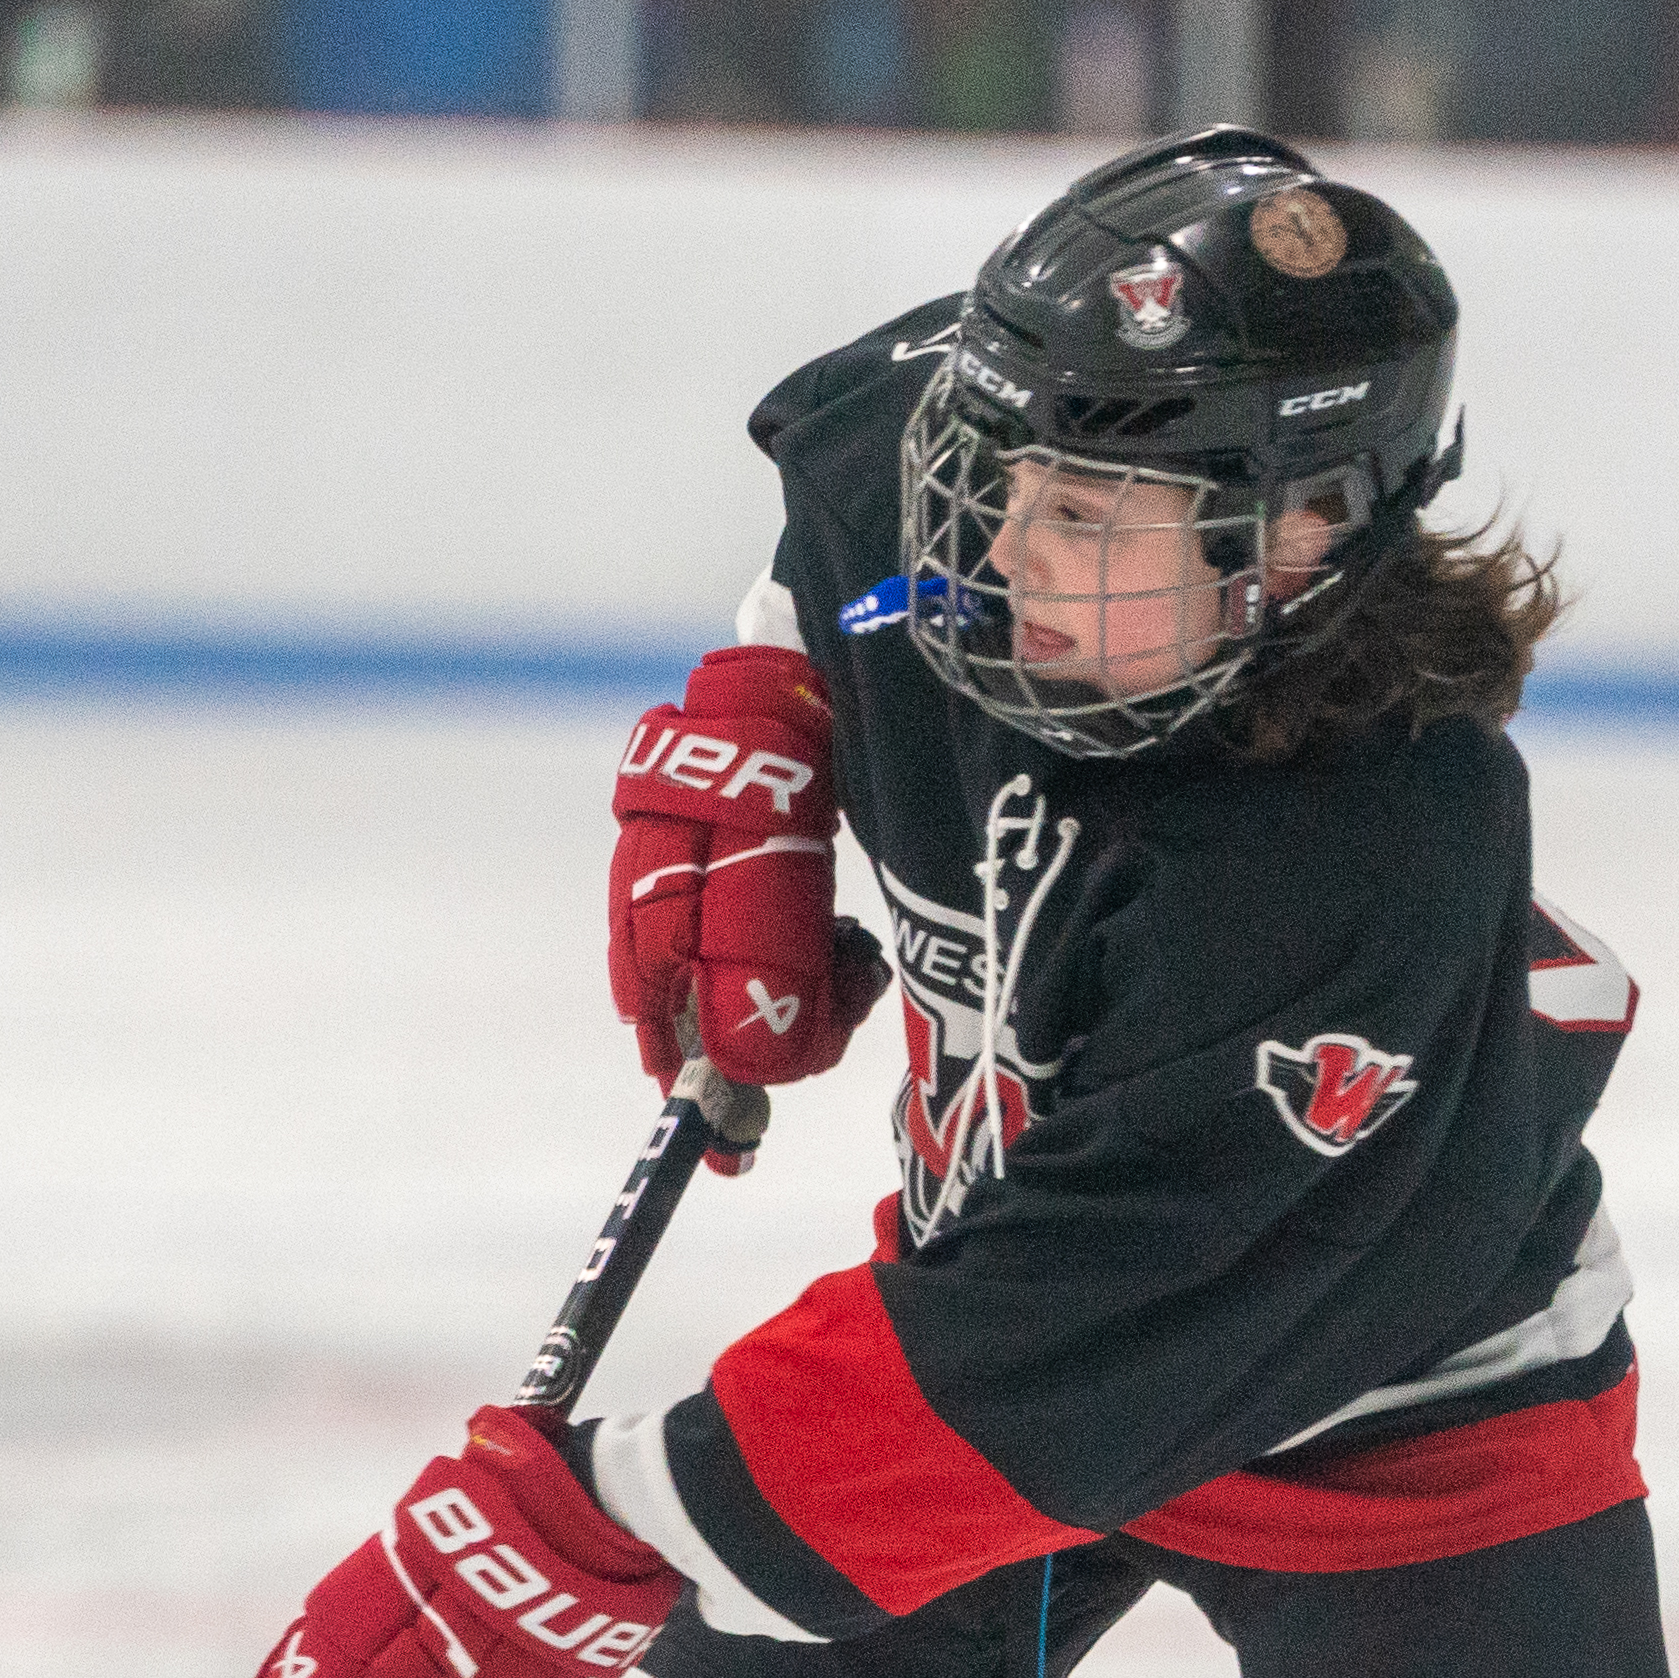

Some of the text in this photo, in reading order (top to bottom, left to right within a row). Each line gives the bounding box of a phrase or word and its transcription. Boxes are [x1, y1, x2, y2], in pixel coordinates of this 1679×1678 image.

[959, 350, 1034, 409] CCM
[1280, 381, 1371, 417] CCM
[891, 908, 1019, 1015] WES
[407, 1487, 664, 1669] BAUE
